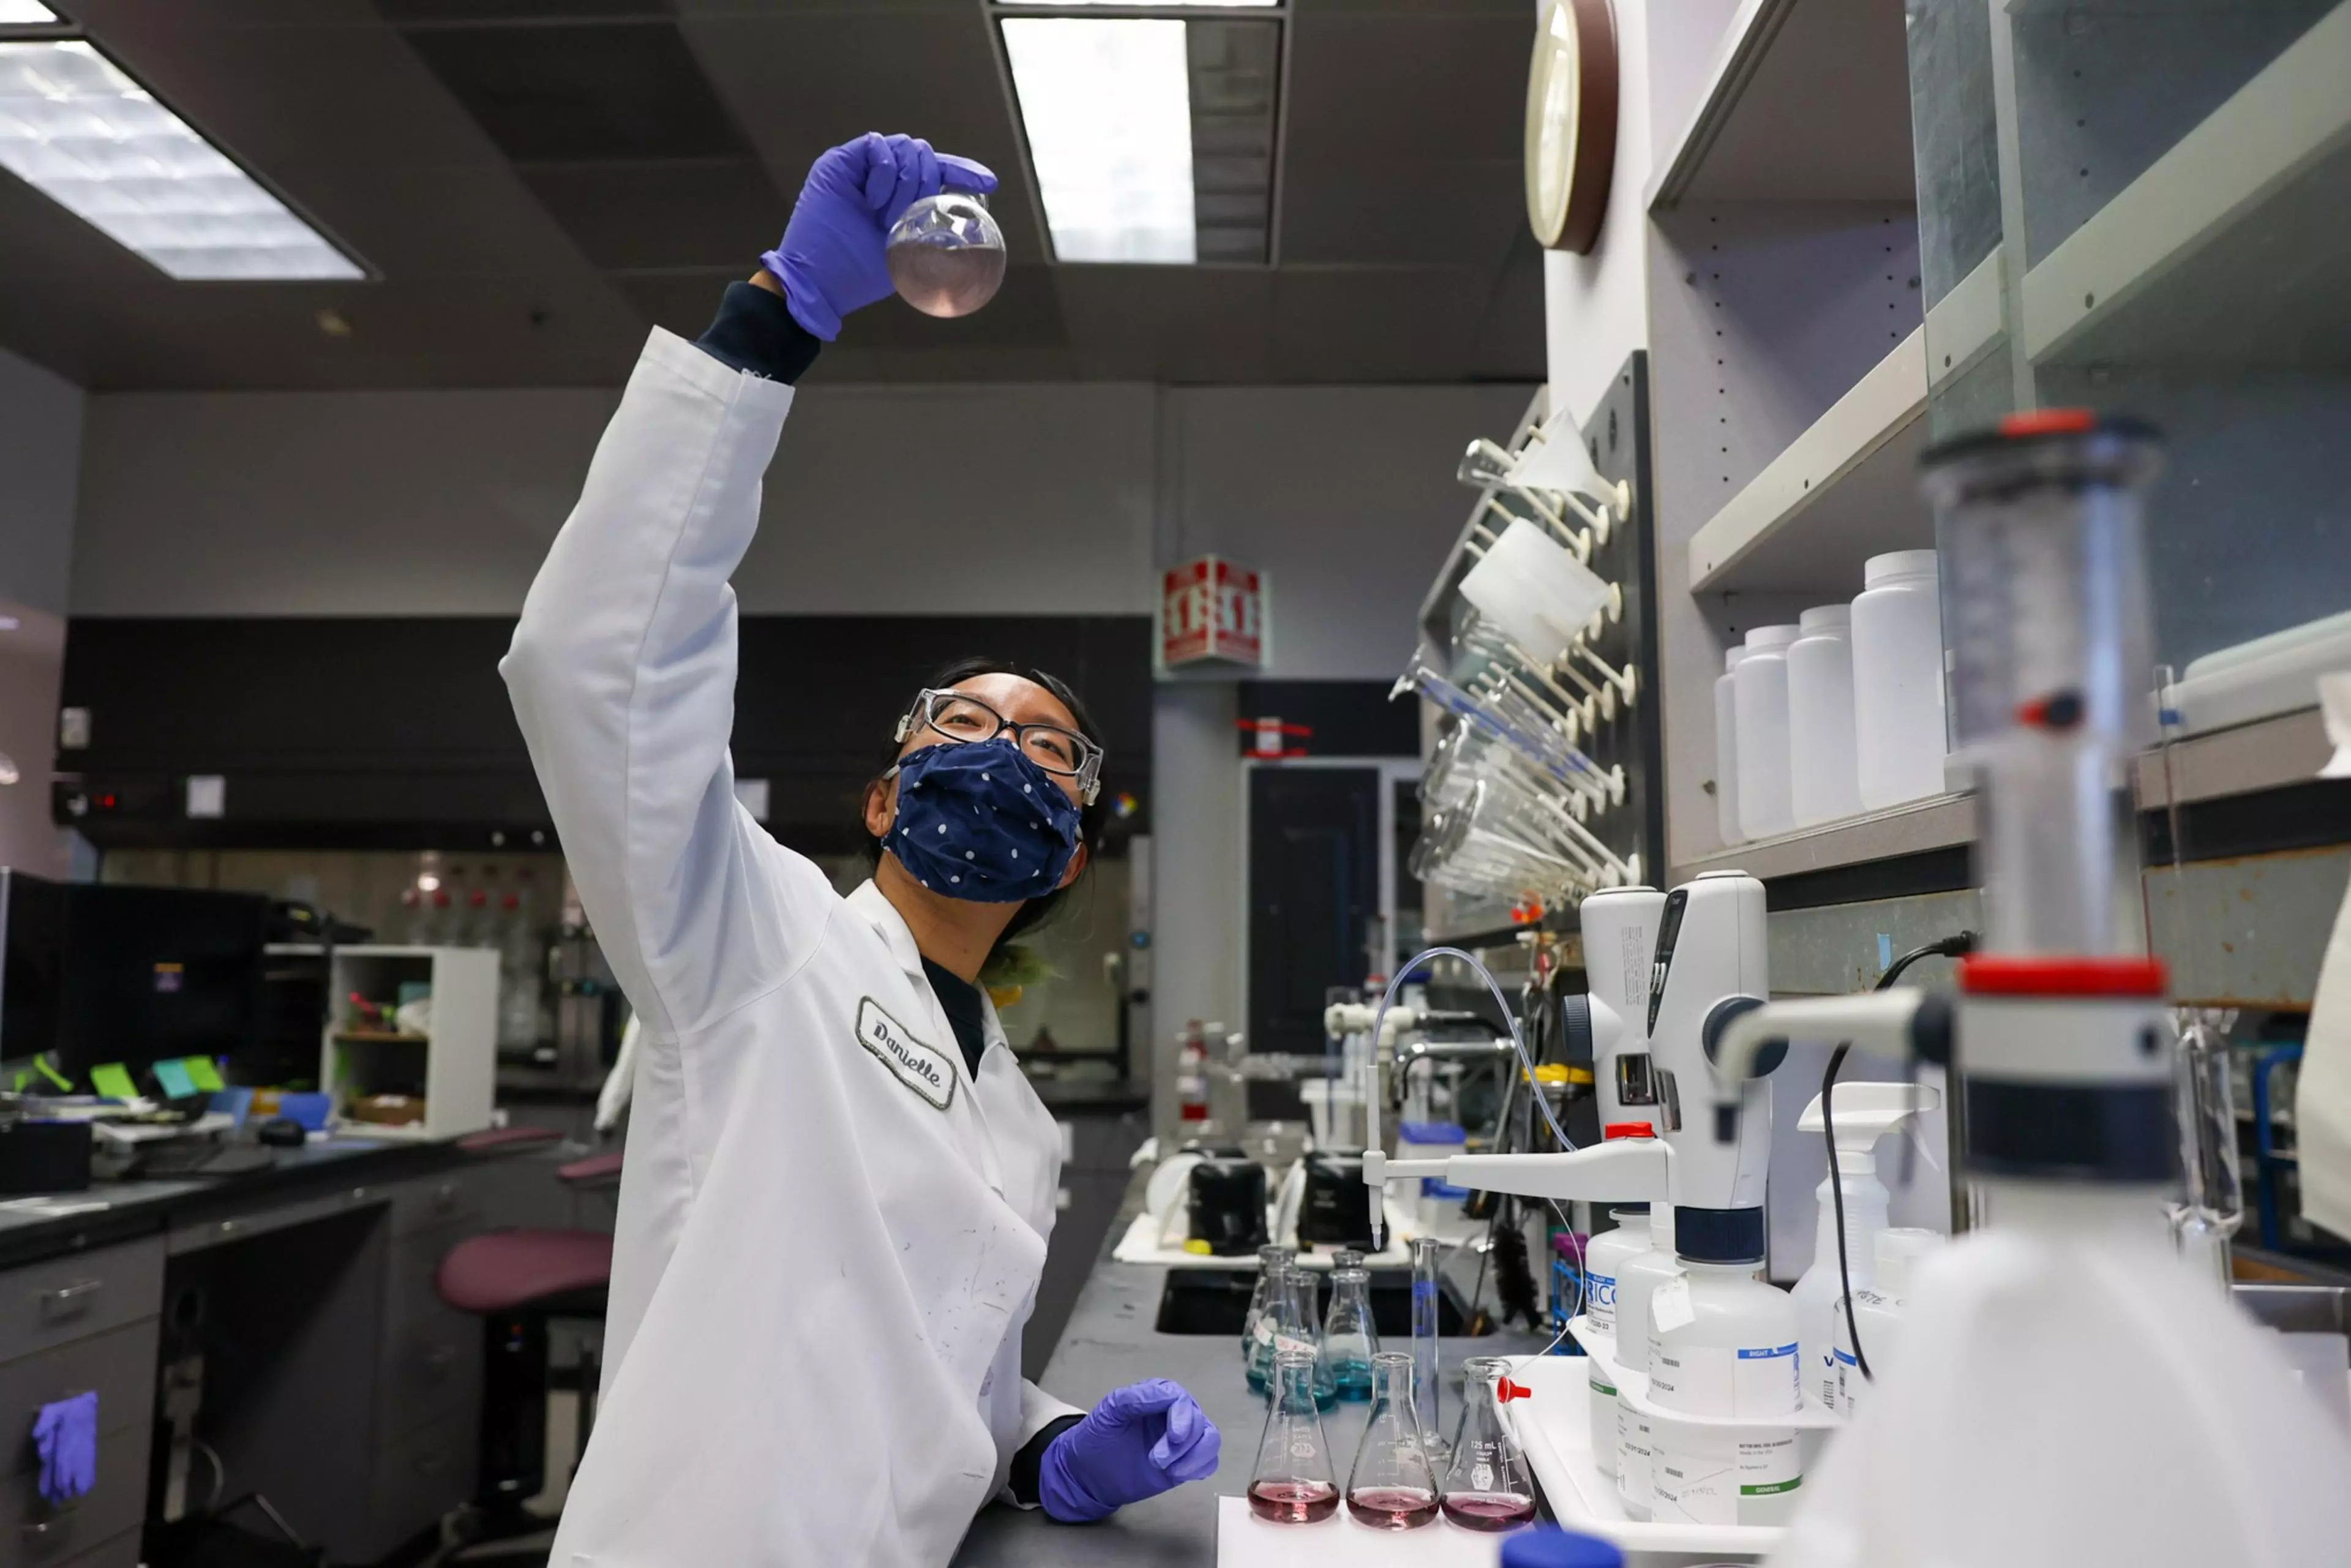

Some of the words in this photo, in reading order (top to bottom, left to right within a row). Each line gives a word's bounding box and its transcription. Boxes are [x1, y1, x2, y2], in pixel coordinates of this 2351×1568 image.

[873, 1019, 940, 1087] Danielle
[1471, 1440, 1482, 1450] 125
[1485, 1441, 1497, 1450] mL
